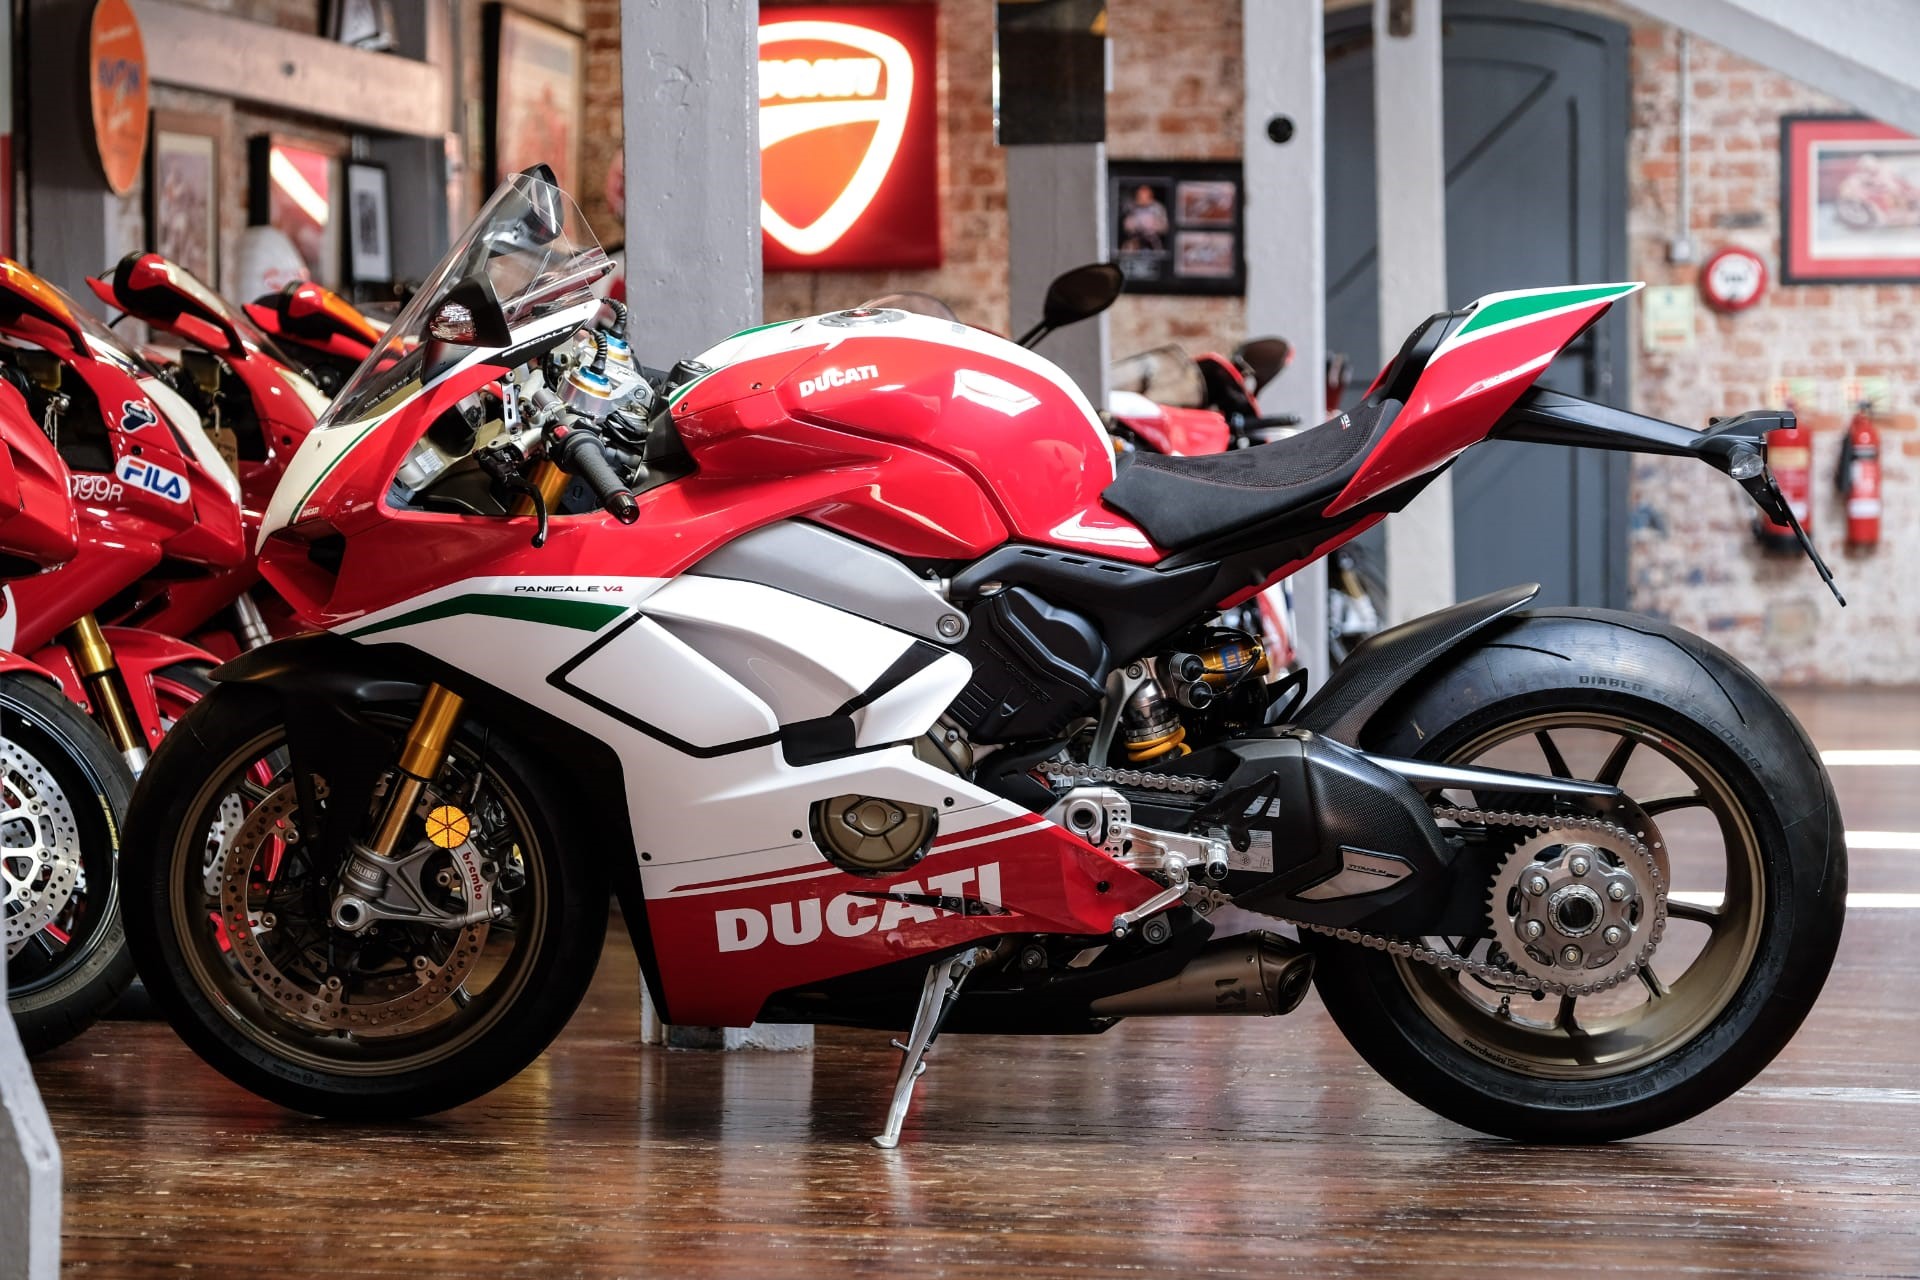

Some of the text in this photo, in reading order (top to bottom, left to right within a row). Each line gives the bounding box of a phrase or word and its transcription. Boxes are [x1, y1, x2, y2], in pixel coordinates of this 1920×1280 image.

[758, 58, 882, 99] UCATI
[799, 365, 879, 398] DUCATI
[124, 460, 182, 500] FILA
[1579, 675, 1642, 692] DIABLO
[462, 852, 484, 900] brembo
[715, 862, 1002, 952] DUCATI
